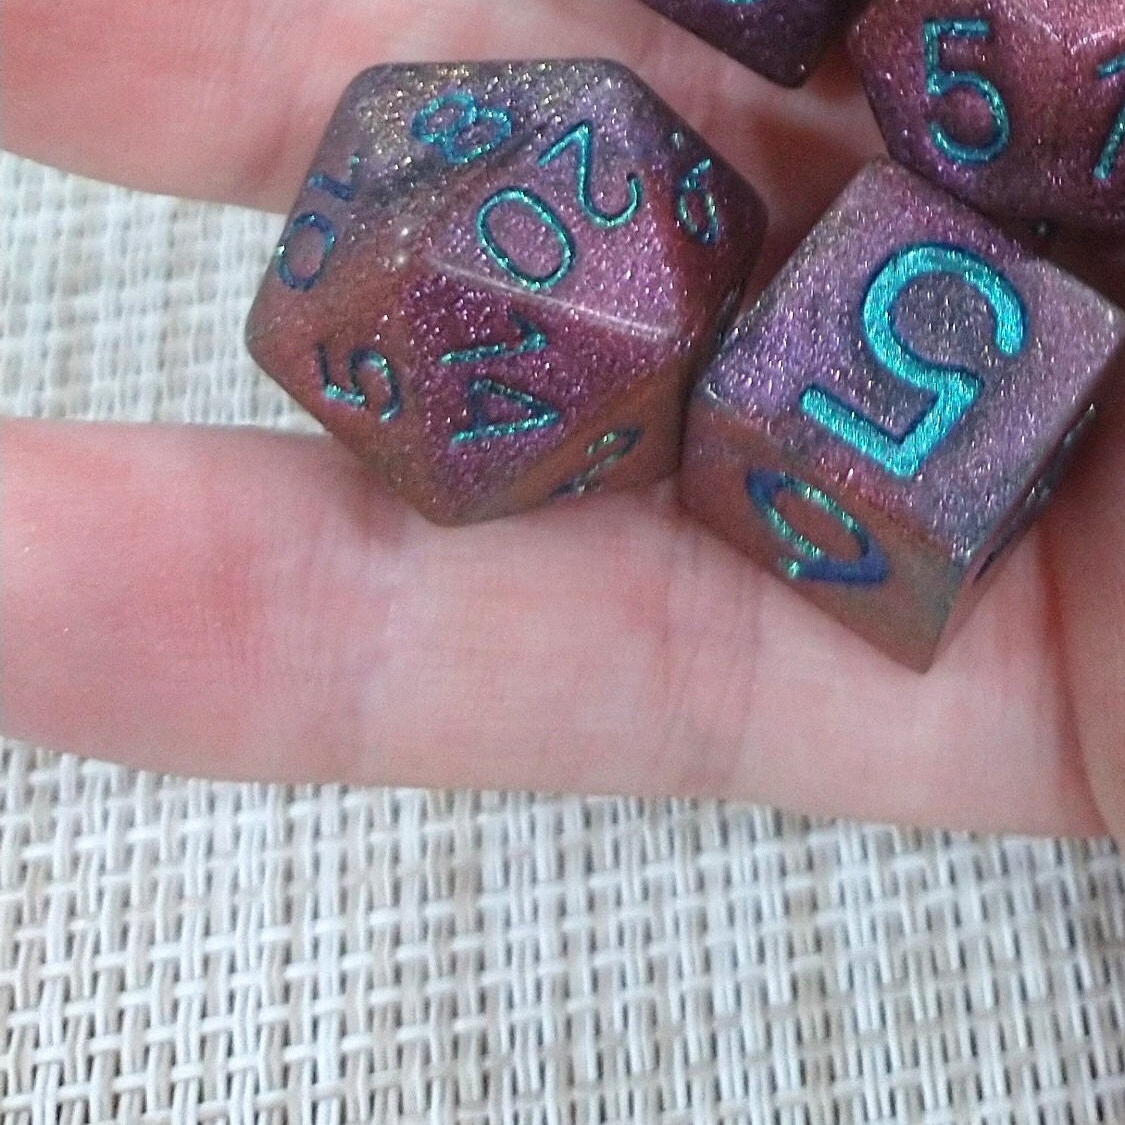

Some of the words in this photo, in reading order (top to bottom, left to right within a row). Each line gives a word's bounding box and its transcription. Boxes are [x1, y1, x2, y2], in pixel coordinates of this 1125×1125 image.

[411, 90, 513, 164] 8
[922, 17, 1011, 165] 5
[475, 118, 643, 294] 20
[315, 341, 400, 424] 5
[438, 310, 561, 445] 14
[801, 241, 1028, 479] 5
